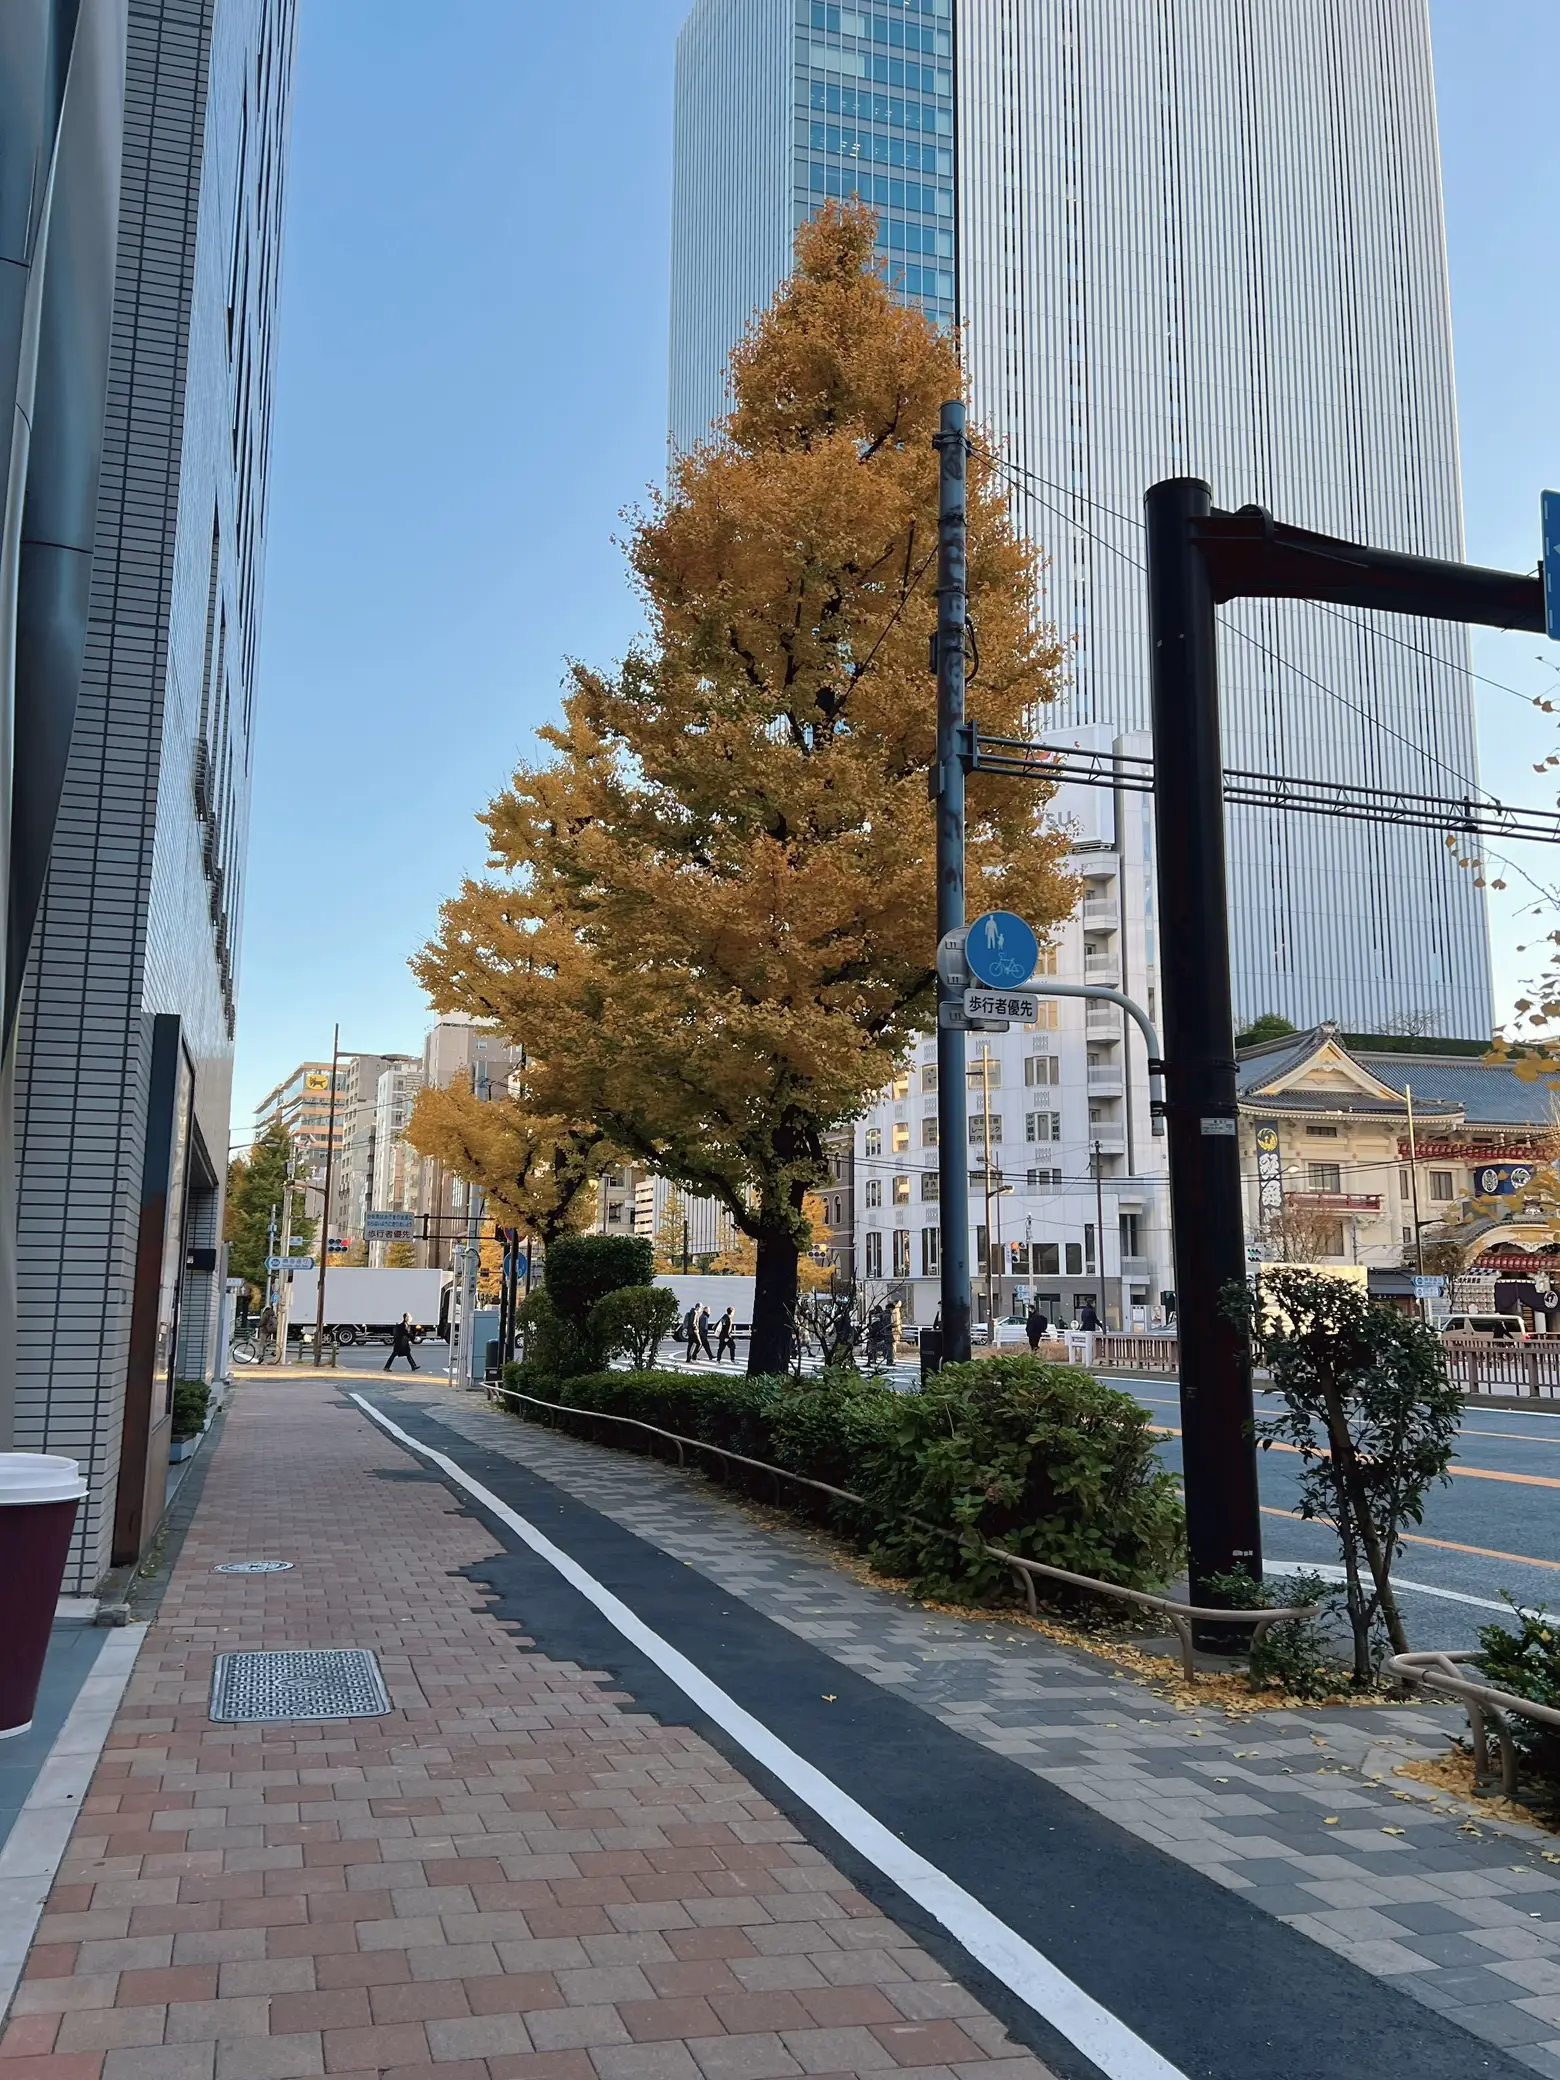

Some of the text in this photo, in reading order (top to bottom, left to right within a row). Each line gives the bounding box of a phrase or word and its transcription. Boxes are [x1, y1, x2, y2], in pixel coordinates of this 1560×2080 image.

[969, 995, 1033, 1017] 歩行者優先
[368, 1229, 411, 1239] 歩行者優先
